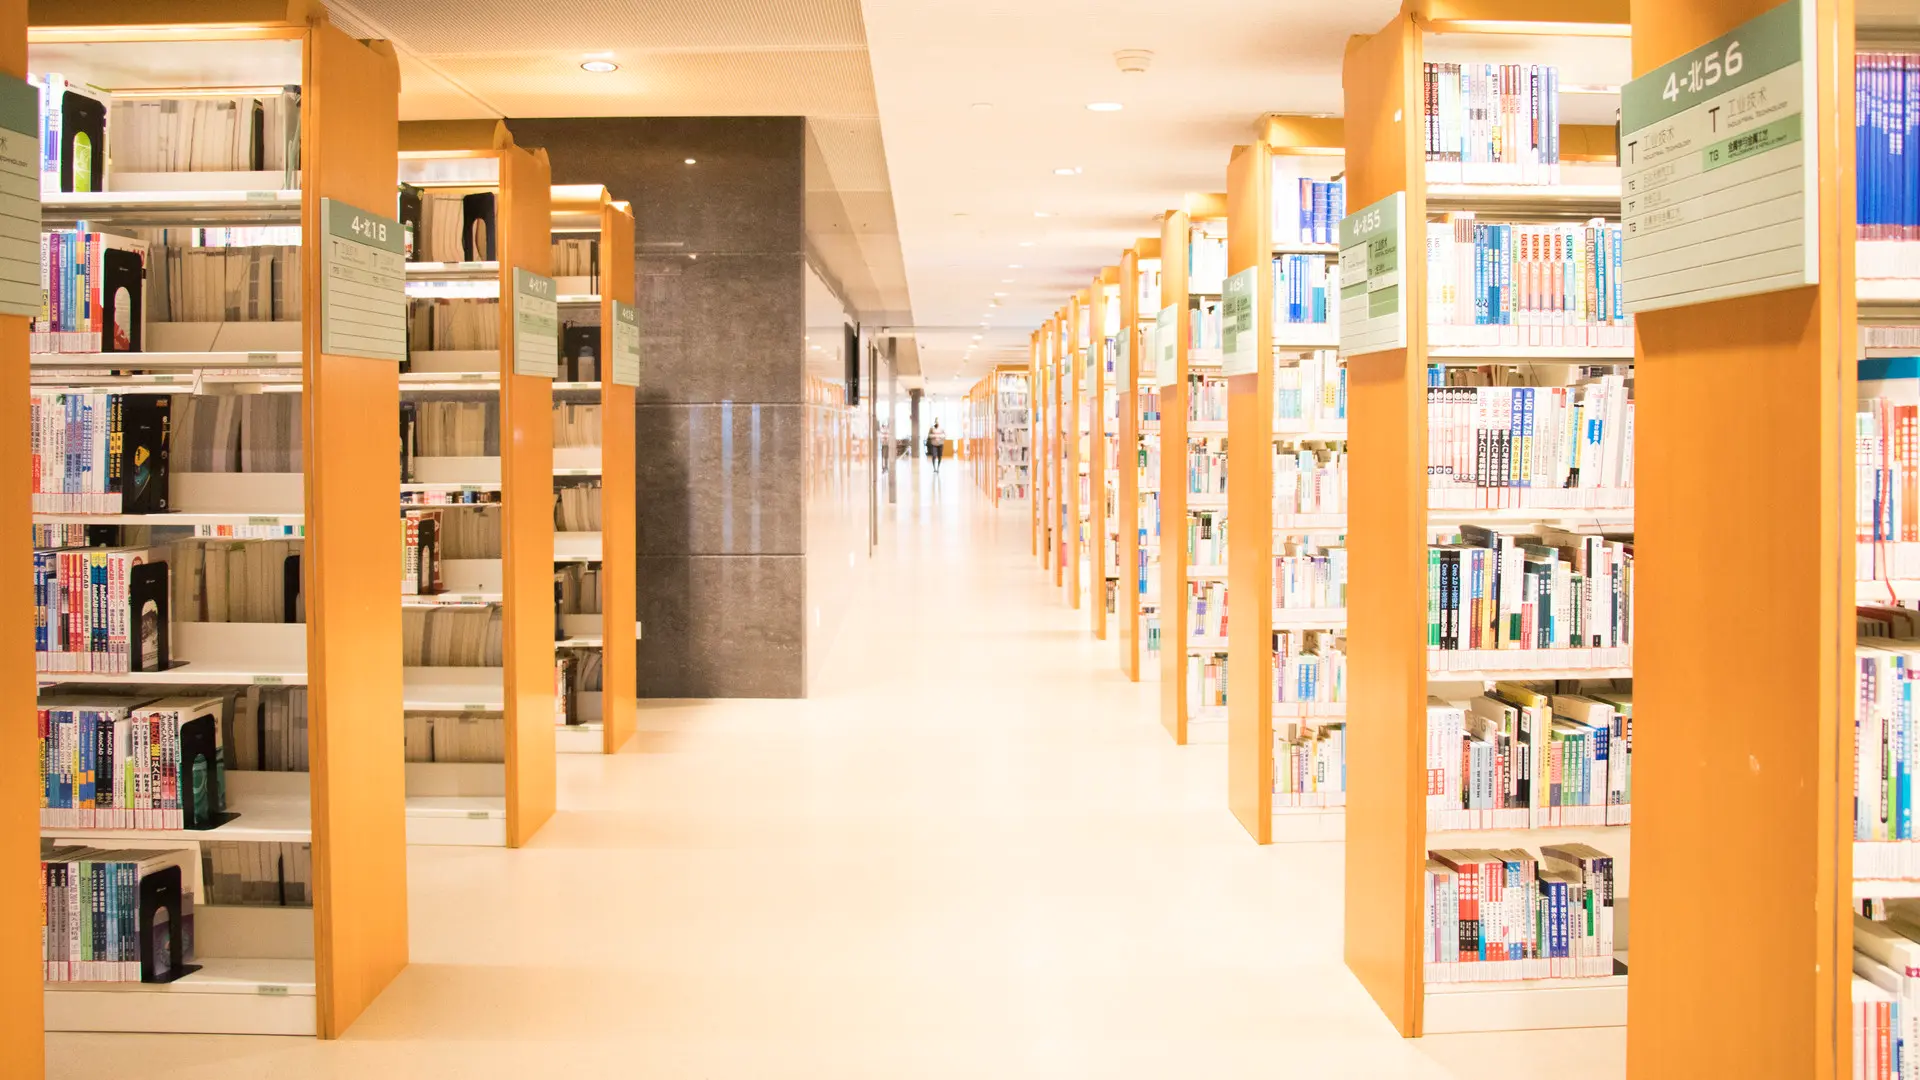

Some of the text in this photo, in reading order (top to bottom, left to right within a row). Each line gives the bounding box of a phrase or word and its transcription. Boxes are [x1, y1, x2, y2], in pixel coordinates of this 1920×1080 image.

[1662, 41, 1743, 102] 4-北56
[1708, 106, 1720, 133] T
[1628, 141, 1637, 164] T
[1709, 149, 1719, 163] TG
[1521, 234, 1527, 259] UG NX
[1532, 234, 1539, 260] UG NX
[1544, 234, 1550, 260] UG NX
[1555, 234, 1561, 260] UG NX
[1566, 235, 1573, 260] UG NX
[1513, 398, 1521, 410] UG
[1524, 398, 1532, 410] UG
[1513, 413, 1521, 425] NX
[1524, 413, 1532, 425] NX
